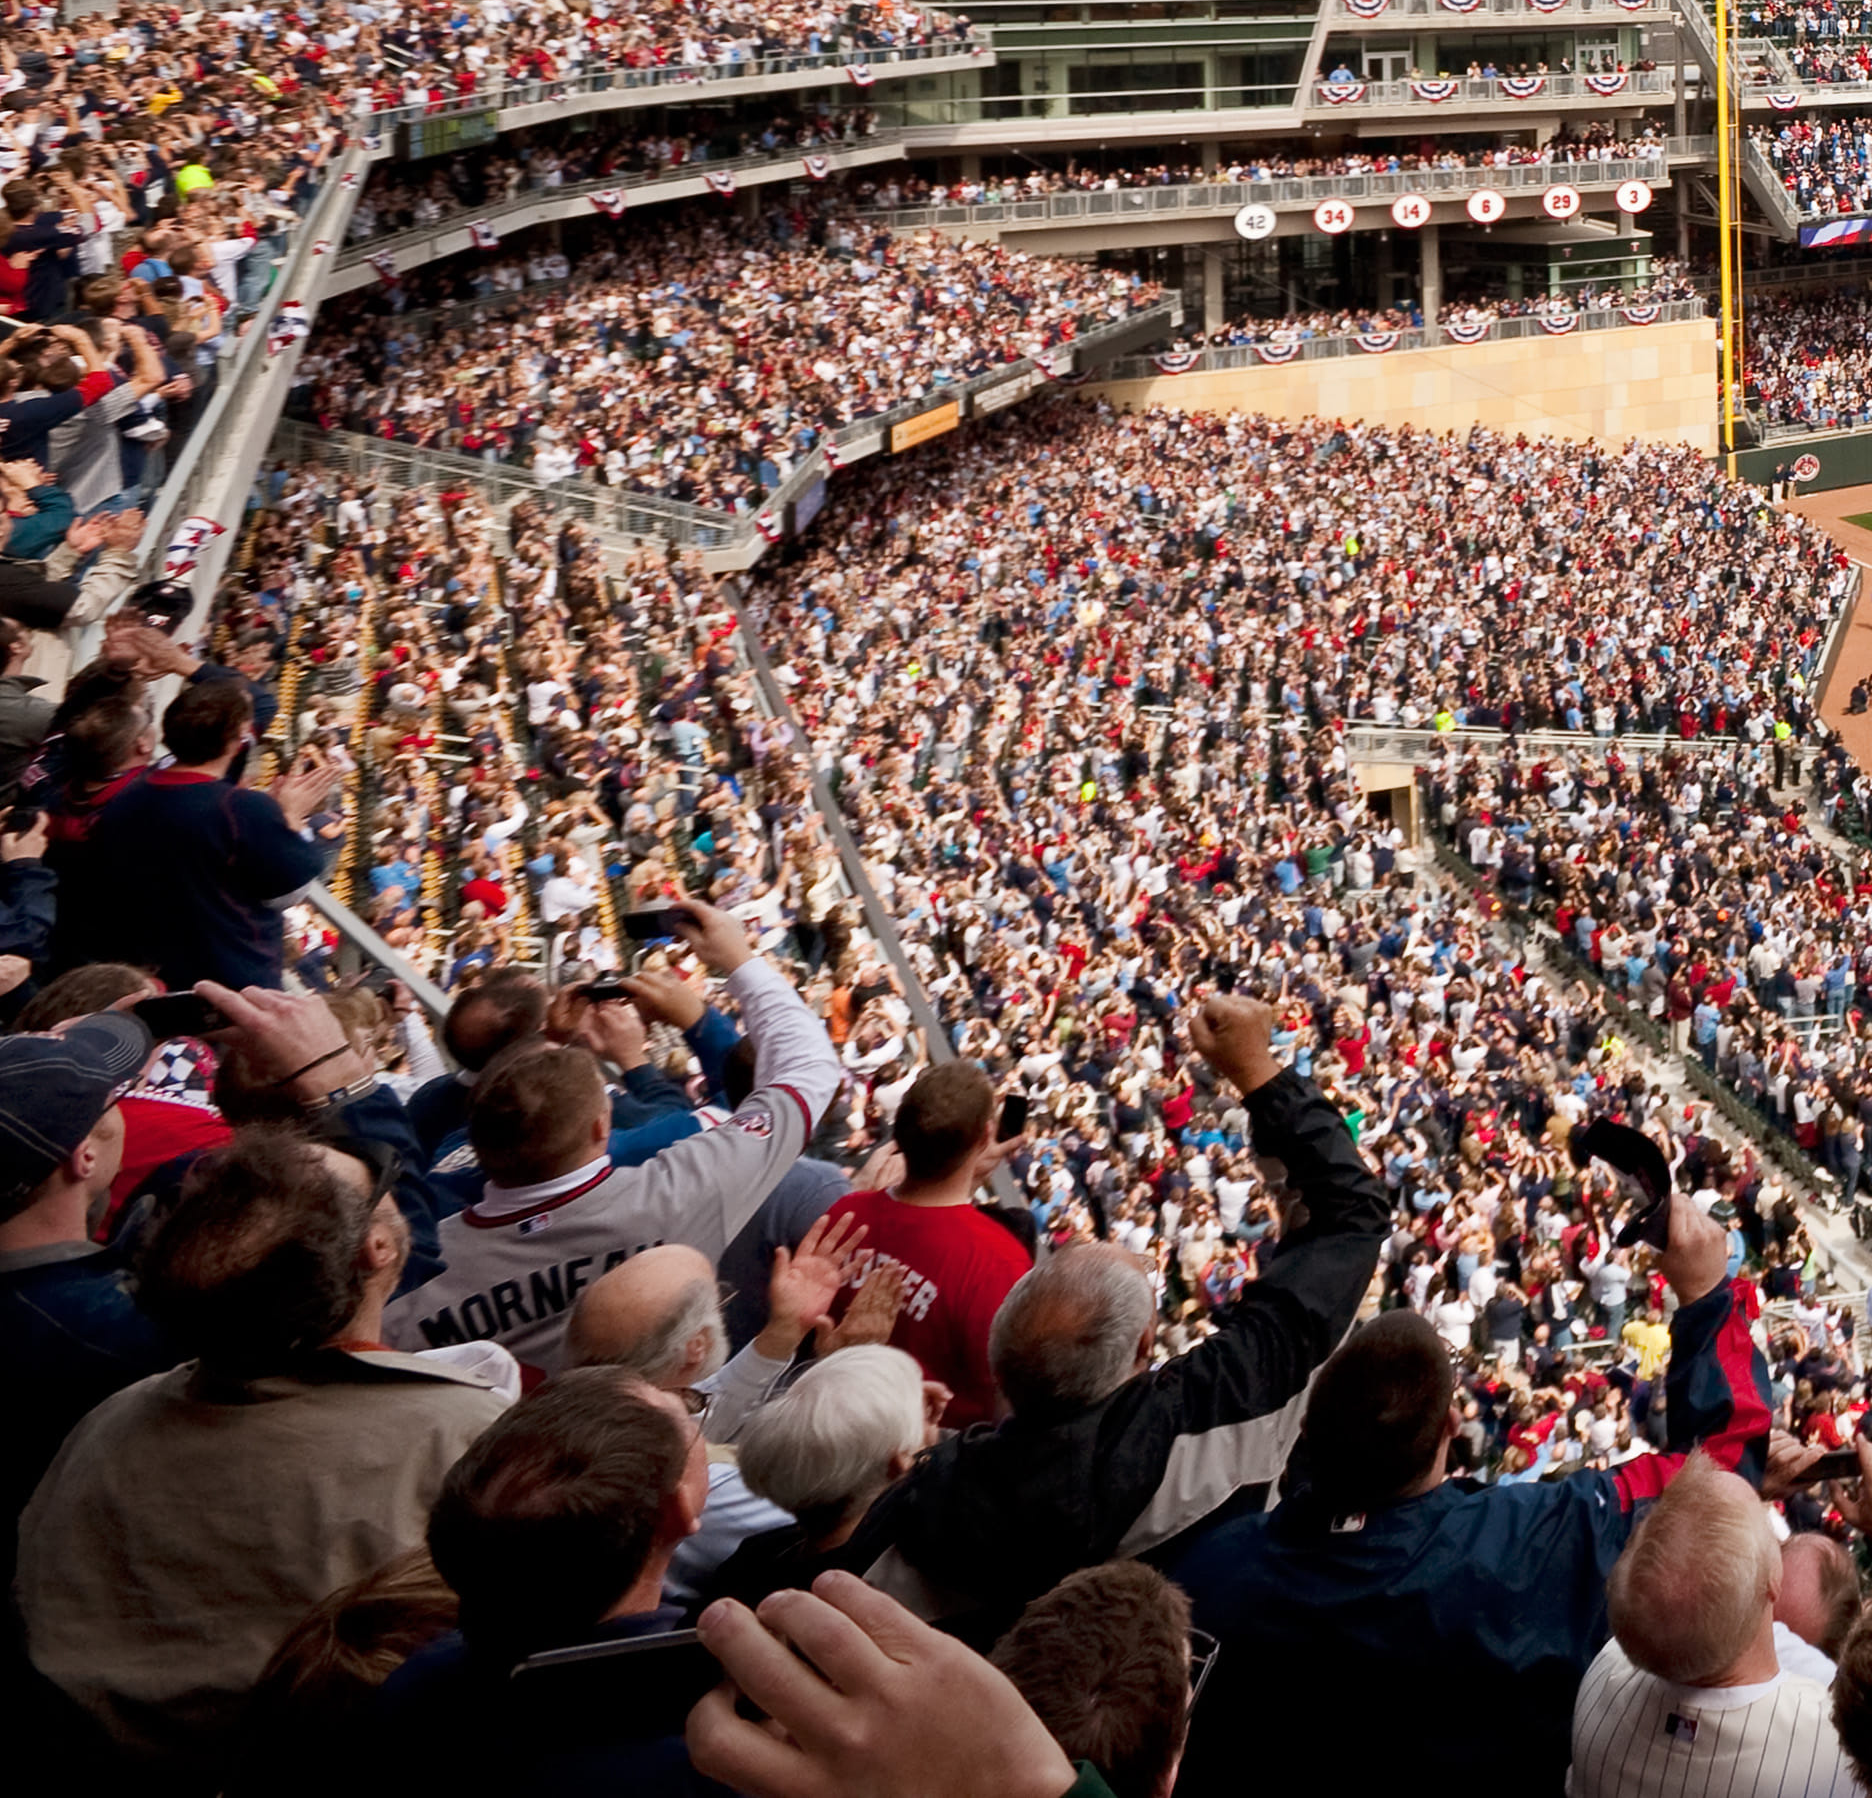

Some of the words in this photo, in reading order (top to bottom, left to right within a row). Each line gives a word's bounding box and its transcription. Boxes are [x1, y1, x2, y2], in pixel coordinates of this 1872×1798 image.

[1552, 195, 1571, 210] 29
[1629, 190, 1639, 204] 3
[1402, 204, 1420, 219] 14
[1482, 198, 1491, 214] 6
[1246, 215, 1265, 230] 42
[1324, 209, 1345, 224] 34
